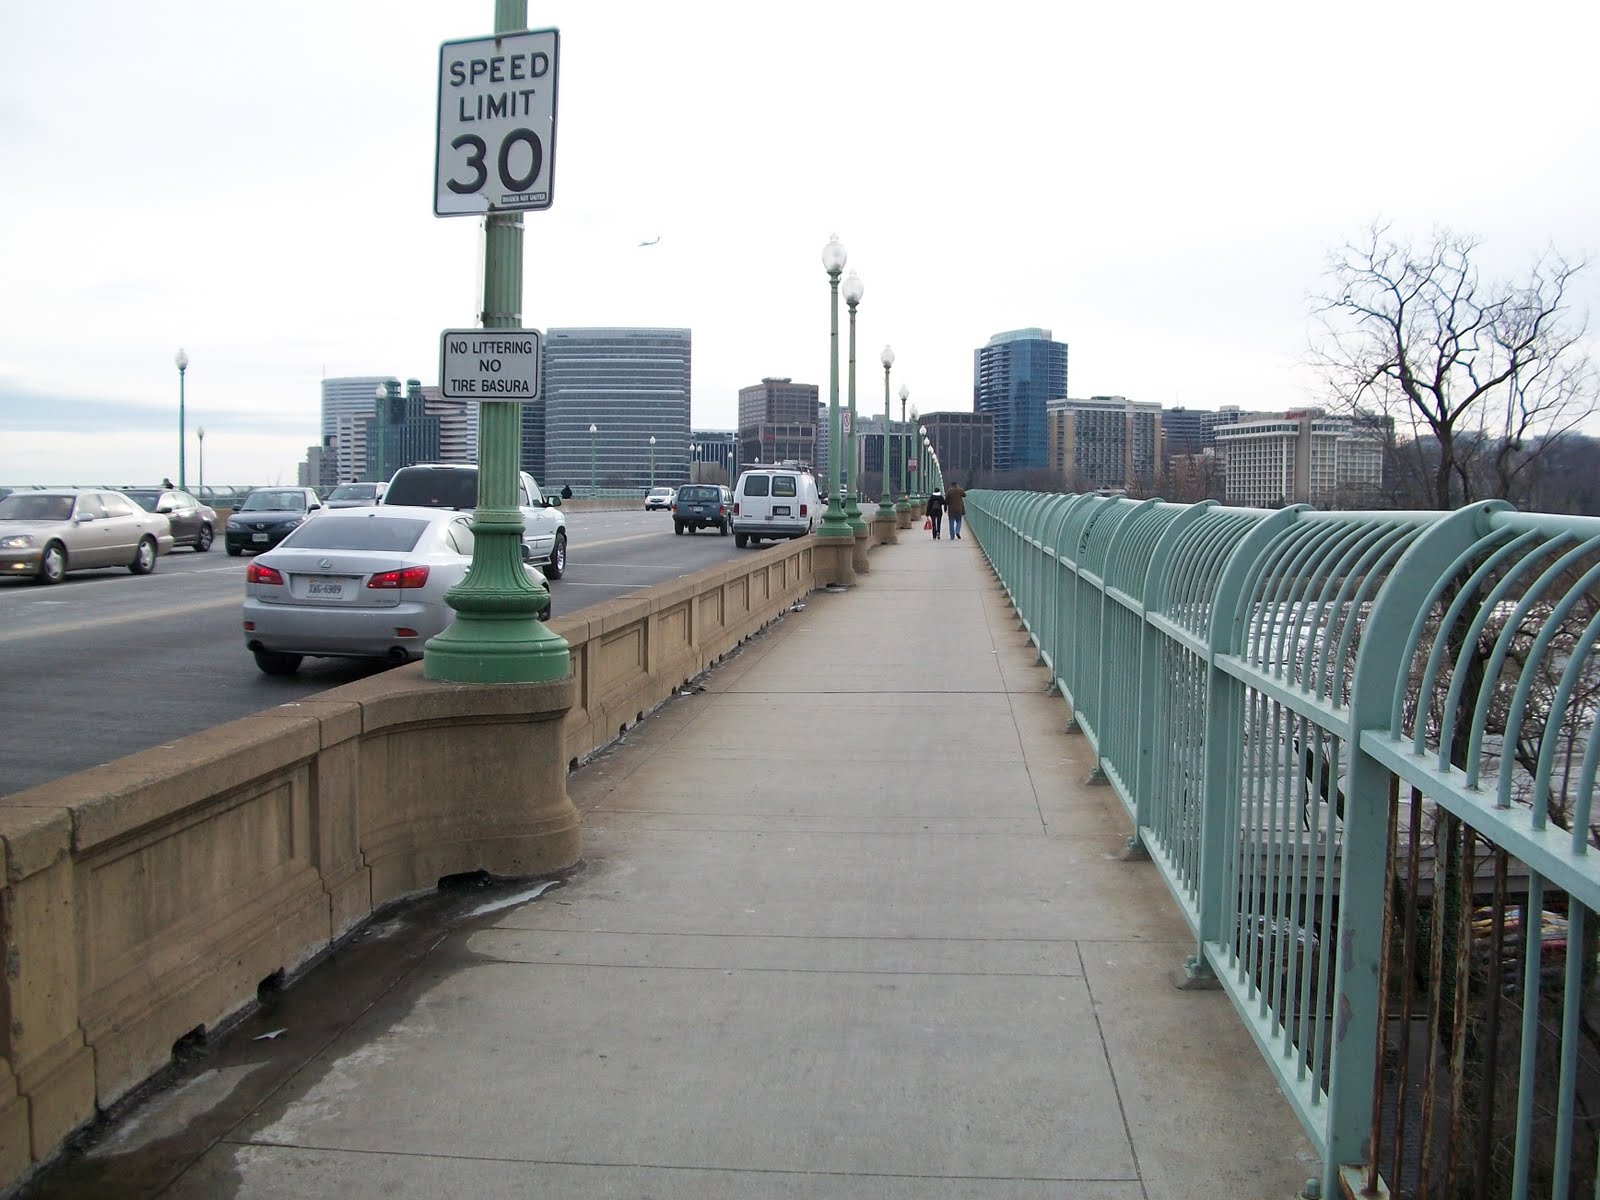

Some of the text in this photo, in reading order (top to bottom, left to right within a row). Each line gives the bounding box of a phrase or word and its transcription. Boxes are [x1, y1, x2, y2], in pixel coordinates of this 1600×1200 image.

[450, 51, 549, 87] SPEED
[459, 88, 535, 122] LIMIT
[446, 127, 543, 194] 30
[520, 194, 529, 202] NOT
[450, 341, 532, 354] NO LITTERING
[479, 359, 502, 372] NO
[450, 379, 529, 393] TIRE BASURA
